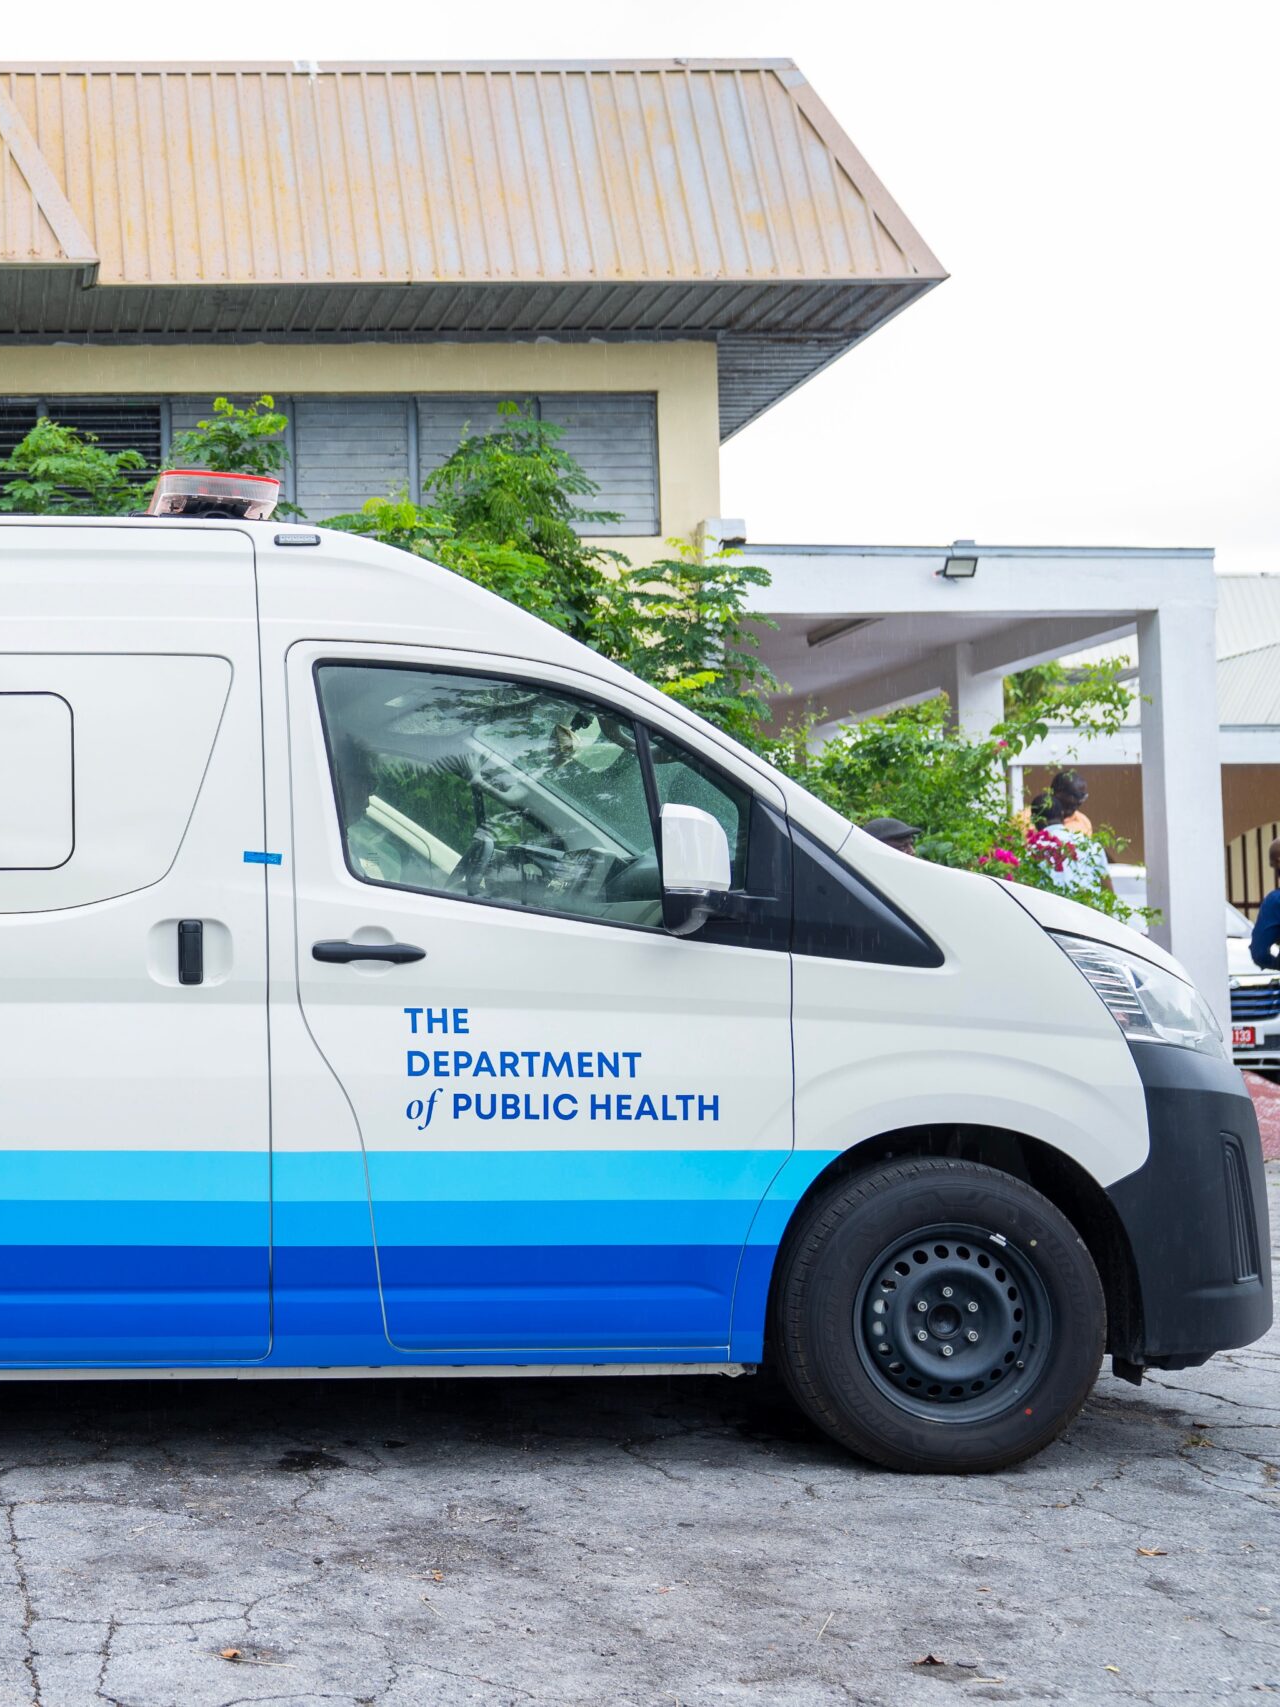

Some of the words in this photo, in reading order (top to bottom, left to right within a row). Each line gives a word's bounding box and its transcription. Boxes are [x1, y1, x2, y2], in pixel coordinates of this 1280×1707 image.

[403, 1007, 470, 1034] THE
[406, 1050, 642, 1079] DEPARTMENT
[405, 1088, 444, 1131] of
[453, 1094, 579, 1121] PUBLIC
[590, 1094, 719, 1121] HEALTH
